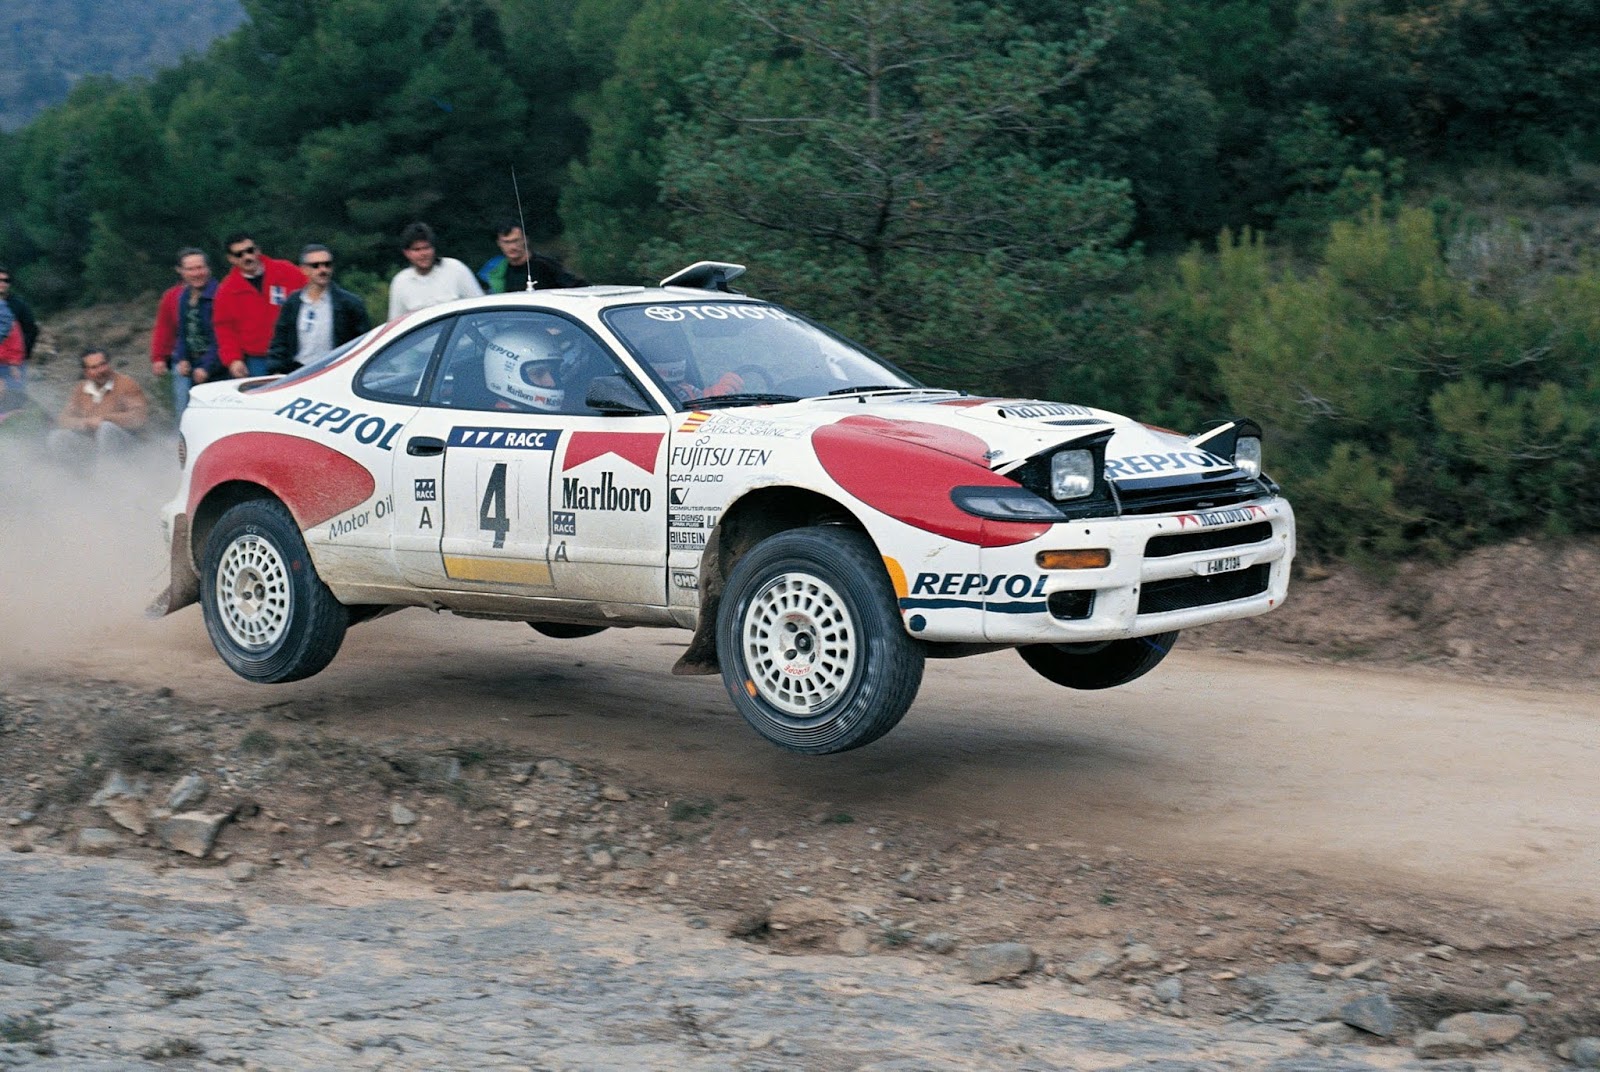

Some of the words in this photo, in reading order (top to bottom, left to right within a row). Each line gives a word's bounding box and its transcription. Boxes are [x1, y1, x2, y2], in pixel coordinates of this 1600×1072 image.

[679, 306, 798, 320] TOYOTA
[274, 397, 404, 451] REPSOL
[750, 427, 791, 437] SAINZ
[505, 432, 547, 447] RACC
[736, 448, 773, 466] TEN
[1105, 452, 1230, 478] REPSOL
[670, 474, 692, 482] CAR
[693, 474, 724, 483] AUDIO
[416, 490, 435, 499] RACC
[562, 471, 651, 512] Marlboro
[479, 463, 510, 549] 4
[329, 513, 370, 540] Motor
[375, 494, 394, 519] Oil
[419, 506, 433, 529] A
[554, 524, 574, 533] RACC
[671, 532, 705, 543] BILSTEIN
[555, 541, 570, 562] A
[674, 574, 698, 588] OMP
[911, 573, 1049, 598] REPSOL
